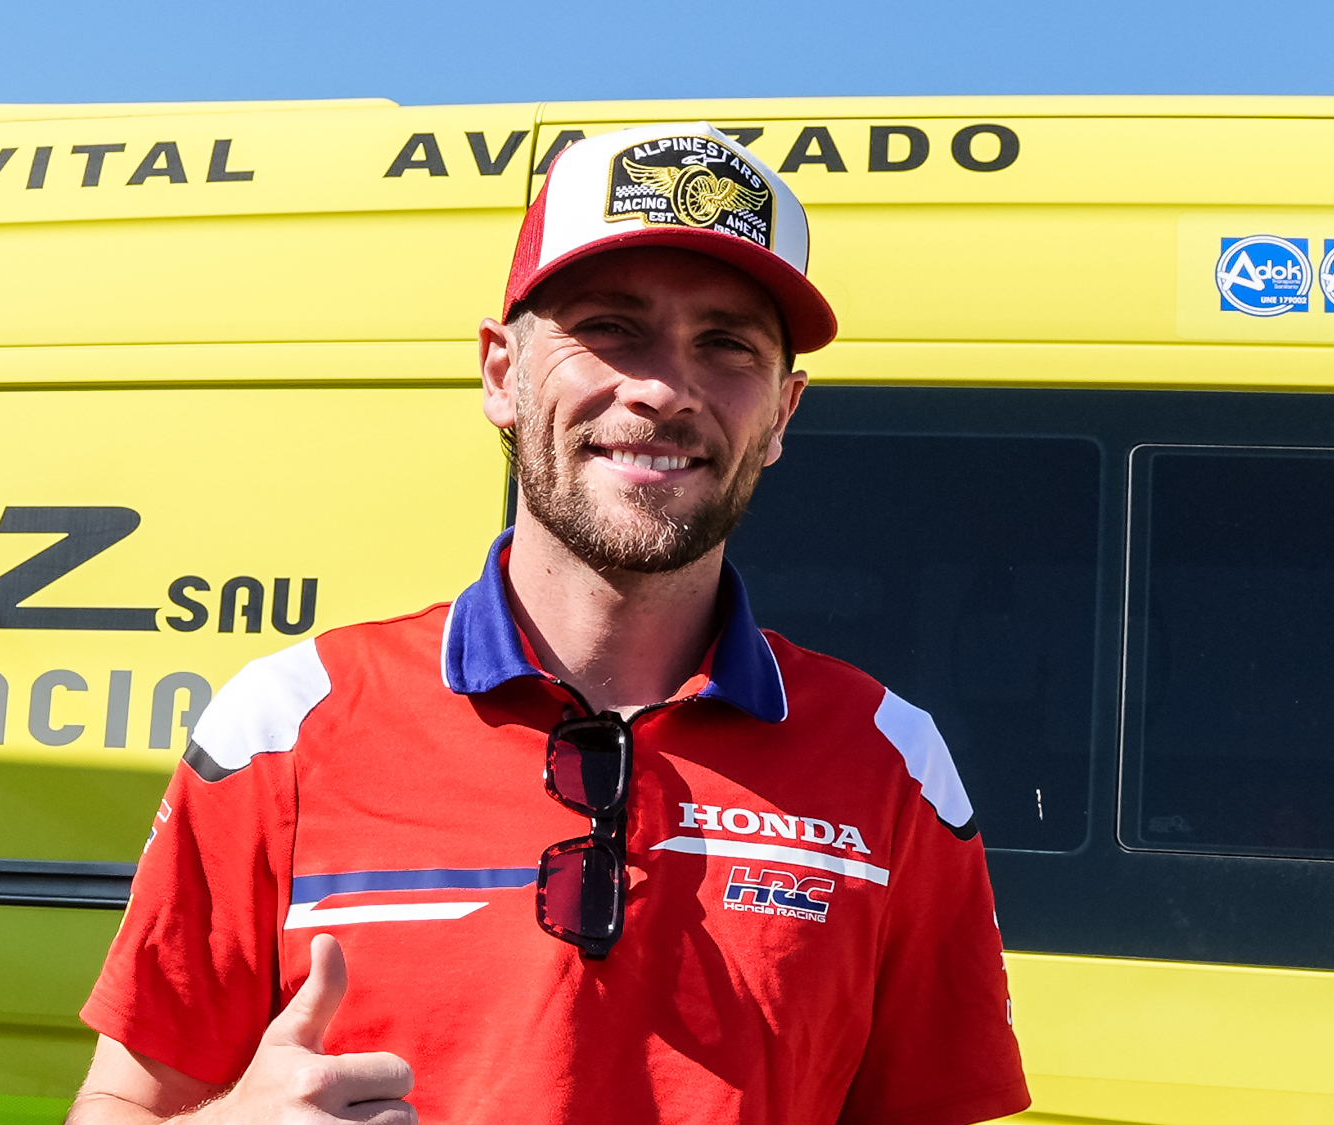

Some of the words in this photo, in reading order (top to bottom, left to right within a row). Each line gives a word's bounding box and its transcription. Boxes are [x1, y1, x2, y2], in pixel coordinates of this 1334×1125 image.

[383, 123, 1020, 178] AVAADO
[633, 137, 762, 189] ALPINESTARS
[613, 197, 667, 213] RACING
[726, 214, 767, 246] AHEAD
[648, 212, 677, 223] EST.
[1217, 250, 1302, 291] Adok
[1260, 296, 1277, 304] UNE
[1279, 296, 1307, 304] 179002
[166, 576, 318, 635] SAU
[678, 802, 871, 854] HONDA
[723, 865, 835, 915] HRC
[723, 902, 775, 915] Honda
[776, 909, 827, 923] RACING
